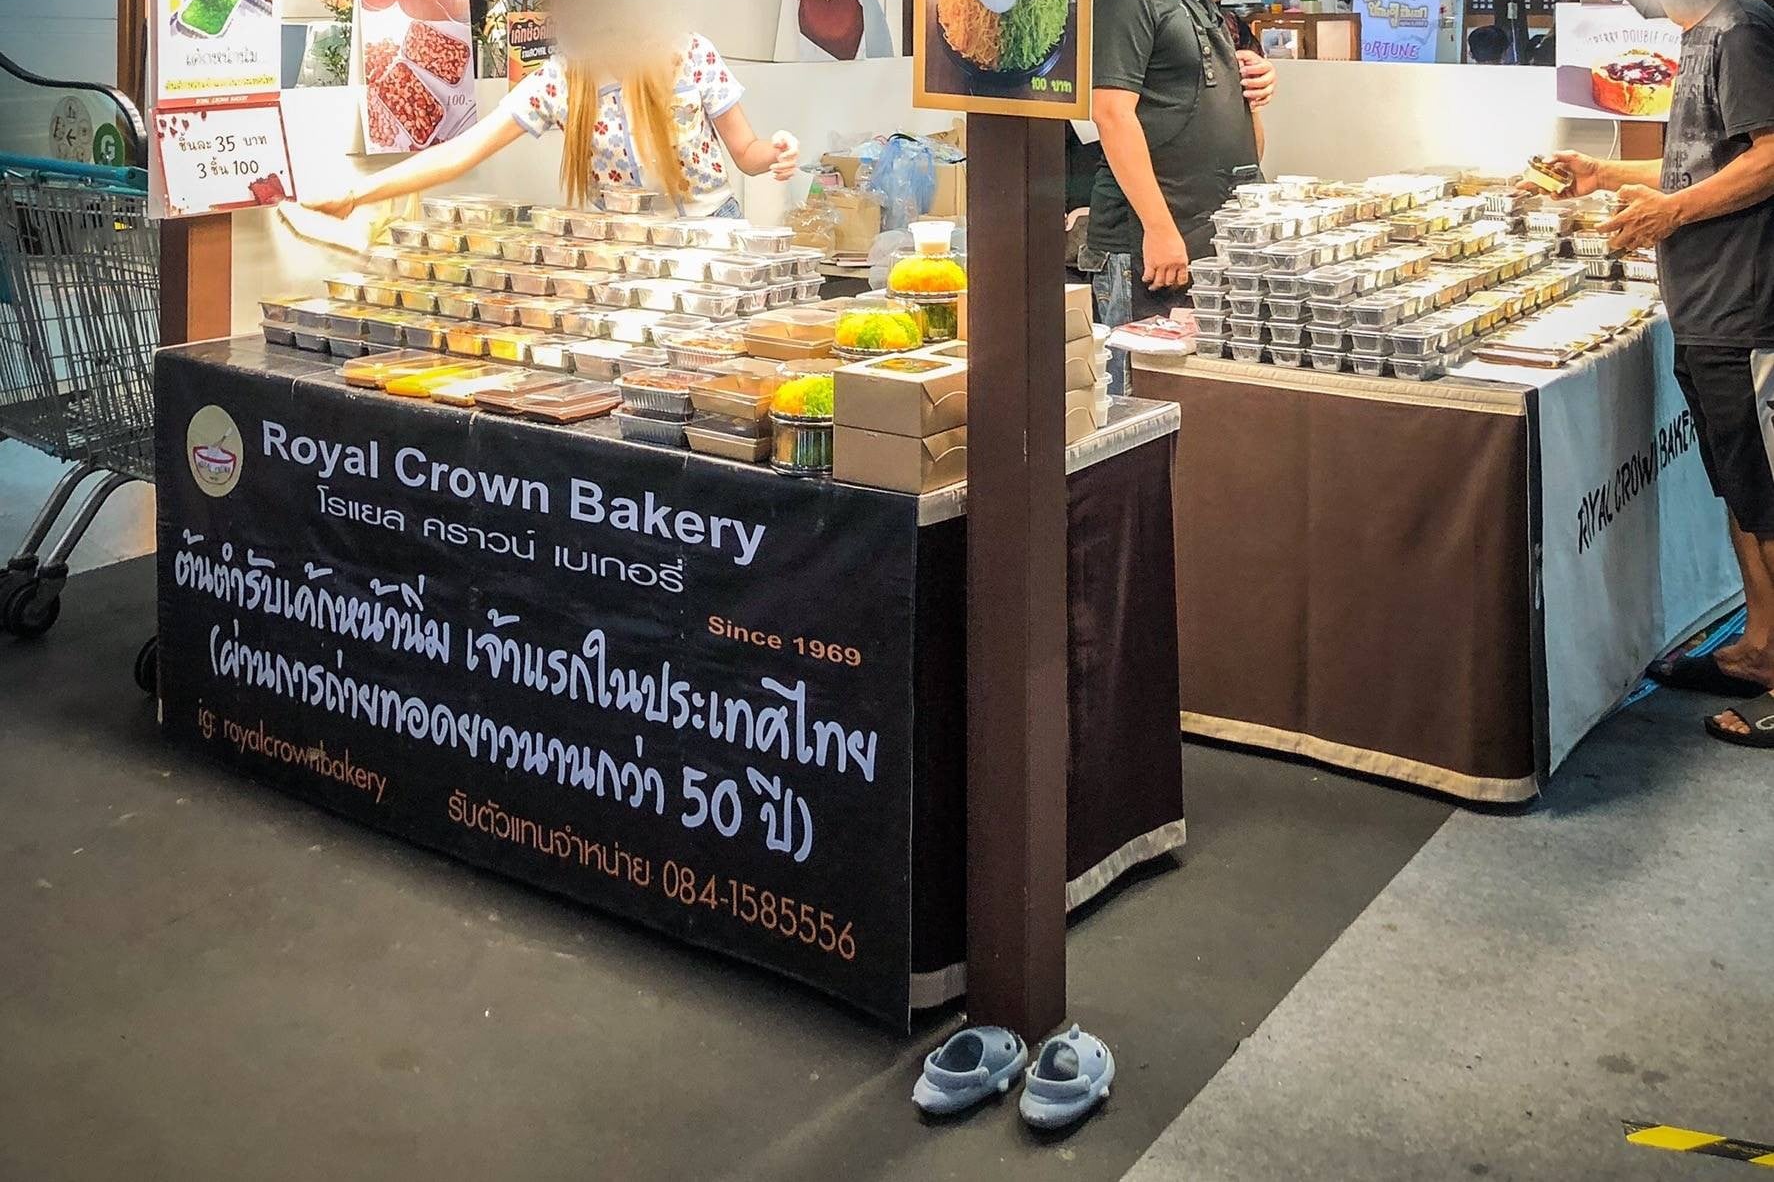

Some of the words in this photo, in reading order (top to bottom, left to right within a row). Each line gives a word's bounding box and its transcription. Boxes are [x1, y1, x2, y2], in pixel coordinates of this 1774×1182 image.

[1361, 41, 1419, 59] ORTUNE
[196, 163, 208, 179] 3
[210, 156, 229, 176] ชิ้น
[233, 160, 259, 176] 100
[215, 135, 236, 153] 35
[243, 134, 268, 147] บาท
[263, 420, 379, 479] Royal
[395, 447, 550, 515] Crown
[570, 477, 766, 567] Bakery
[317, 484, 405, 533] โรแยล
[423, 518, 536, 561] คราวน์
[554, 545, 684, 593] เบเกอรี่
[708, 615, 783, 650] Since
[793, 636, 862, 667] 1969
[466, 608, 878, 782] เจ้าแรกในประเทศไทย
[223, 719, 388, 805] royalcrownbakery
[681, 765, 743, 838] 50
[746, 766, 814, 863] ปี)
[447, 788, 651, 887] รับตัวแทนจำหน่าย
[663, 859, 857, 961] 084-1585556
